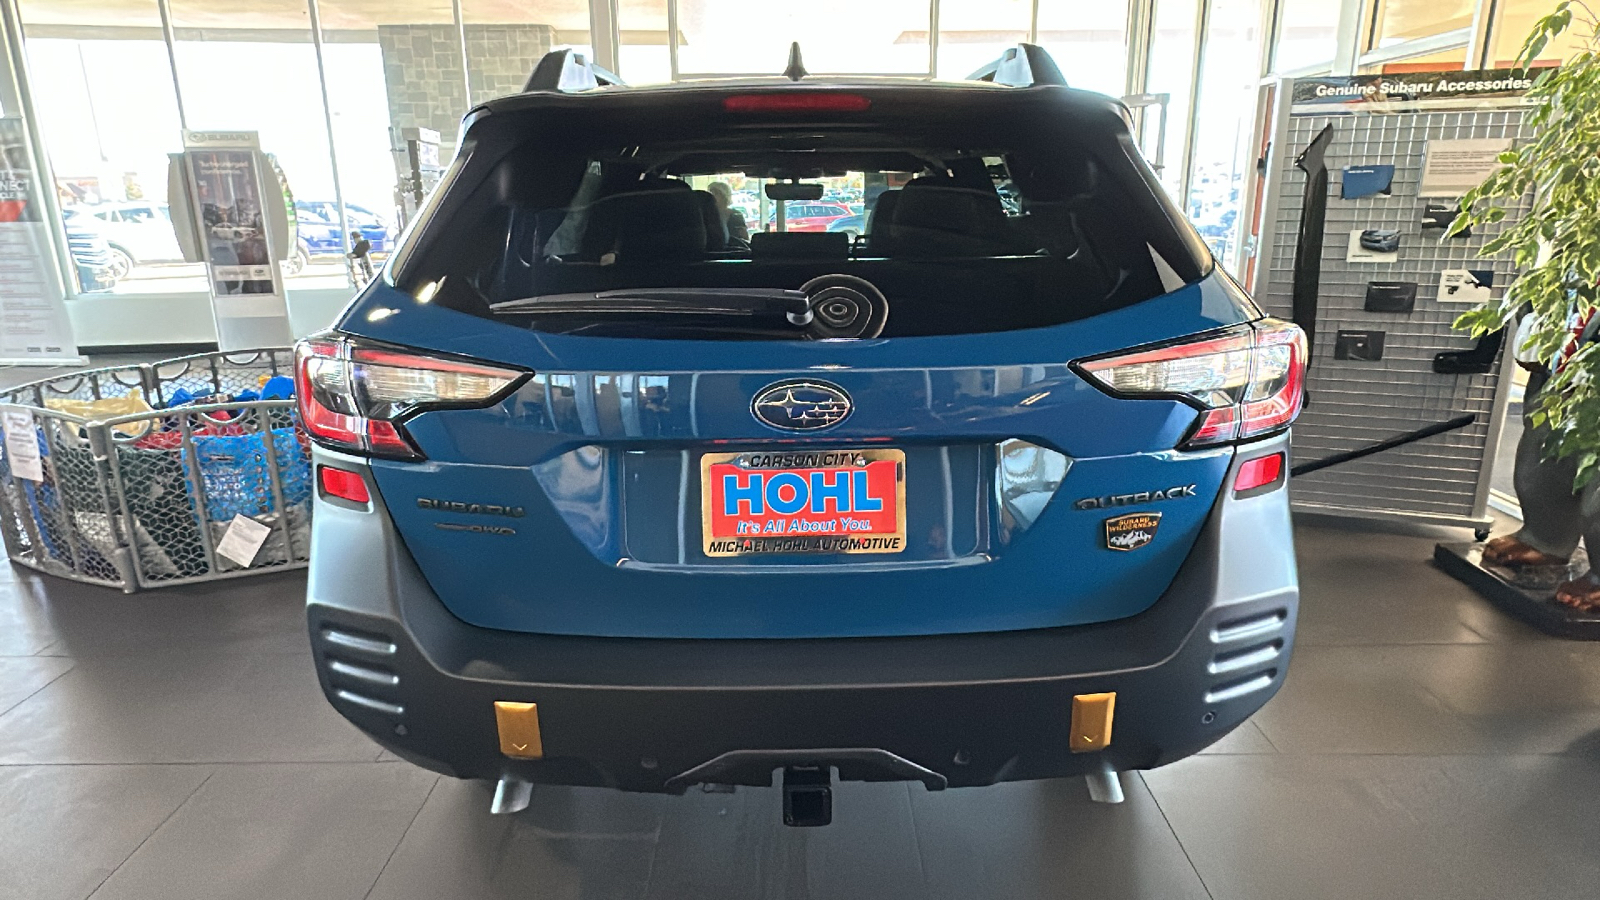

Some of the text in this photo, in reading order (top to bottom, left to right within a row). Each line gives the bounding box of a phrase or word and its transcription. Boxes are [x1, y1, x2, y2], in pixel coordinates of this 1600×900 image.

[1316, 77, 1532, 97] Genuine Subaru Accessories
[750, 453, 860, 468] CARSON CITY
[723, 471, 884, 515] HOHL
[1075, 483, 1197, 510] OUTBACK
[416, 497, 525, 517] SUBARU
[737, 517, 872, 534] It's All About You.
[1109, 521, 1158, 531] WILDERNESS
[1117, 517, 1150, 525] SUBARU
[709, 537, 900, 553] MICHAEL HOHL AUTOMOTIVE
